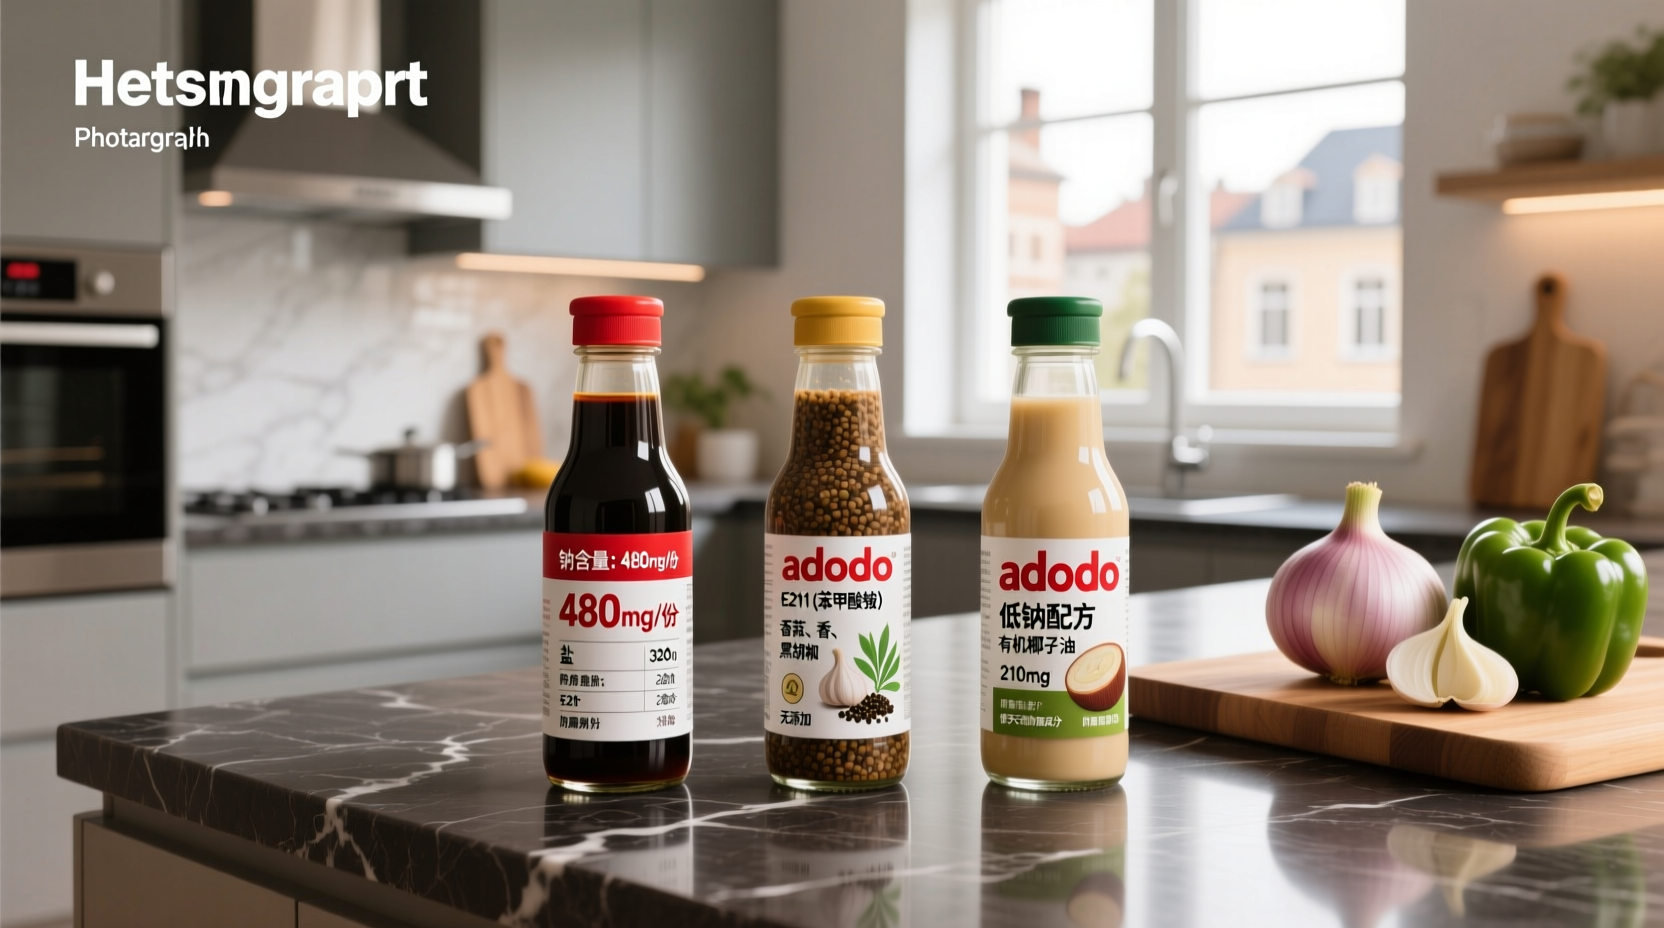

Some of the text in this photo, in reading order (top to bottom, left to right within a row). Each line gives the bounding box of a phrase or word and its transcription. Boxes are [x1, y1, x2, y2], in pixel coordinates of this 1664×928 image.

[782, 546, 893, 582] adodo
[999, 550, 1120, 592] adodo
[999, 602, 1096, 631] 低钠配方
[998, 634, 1076, 655] 有机椰子油
[1000, 664, 1051, 688] 210mg
